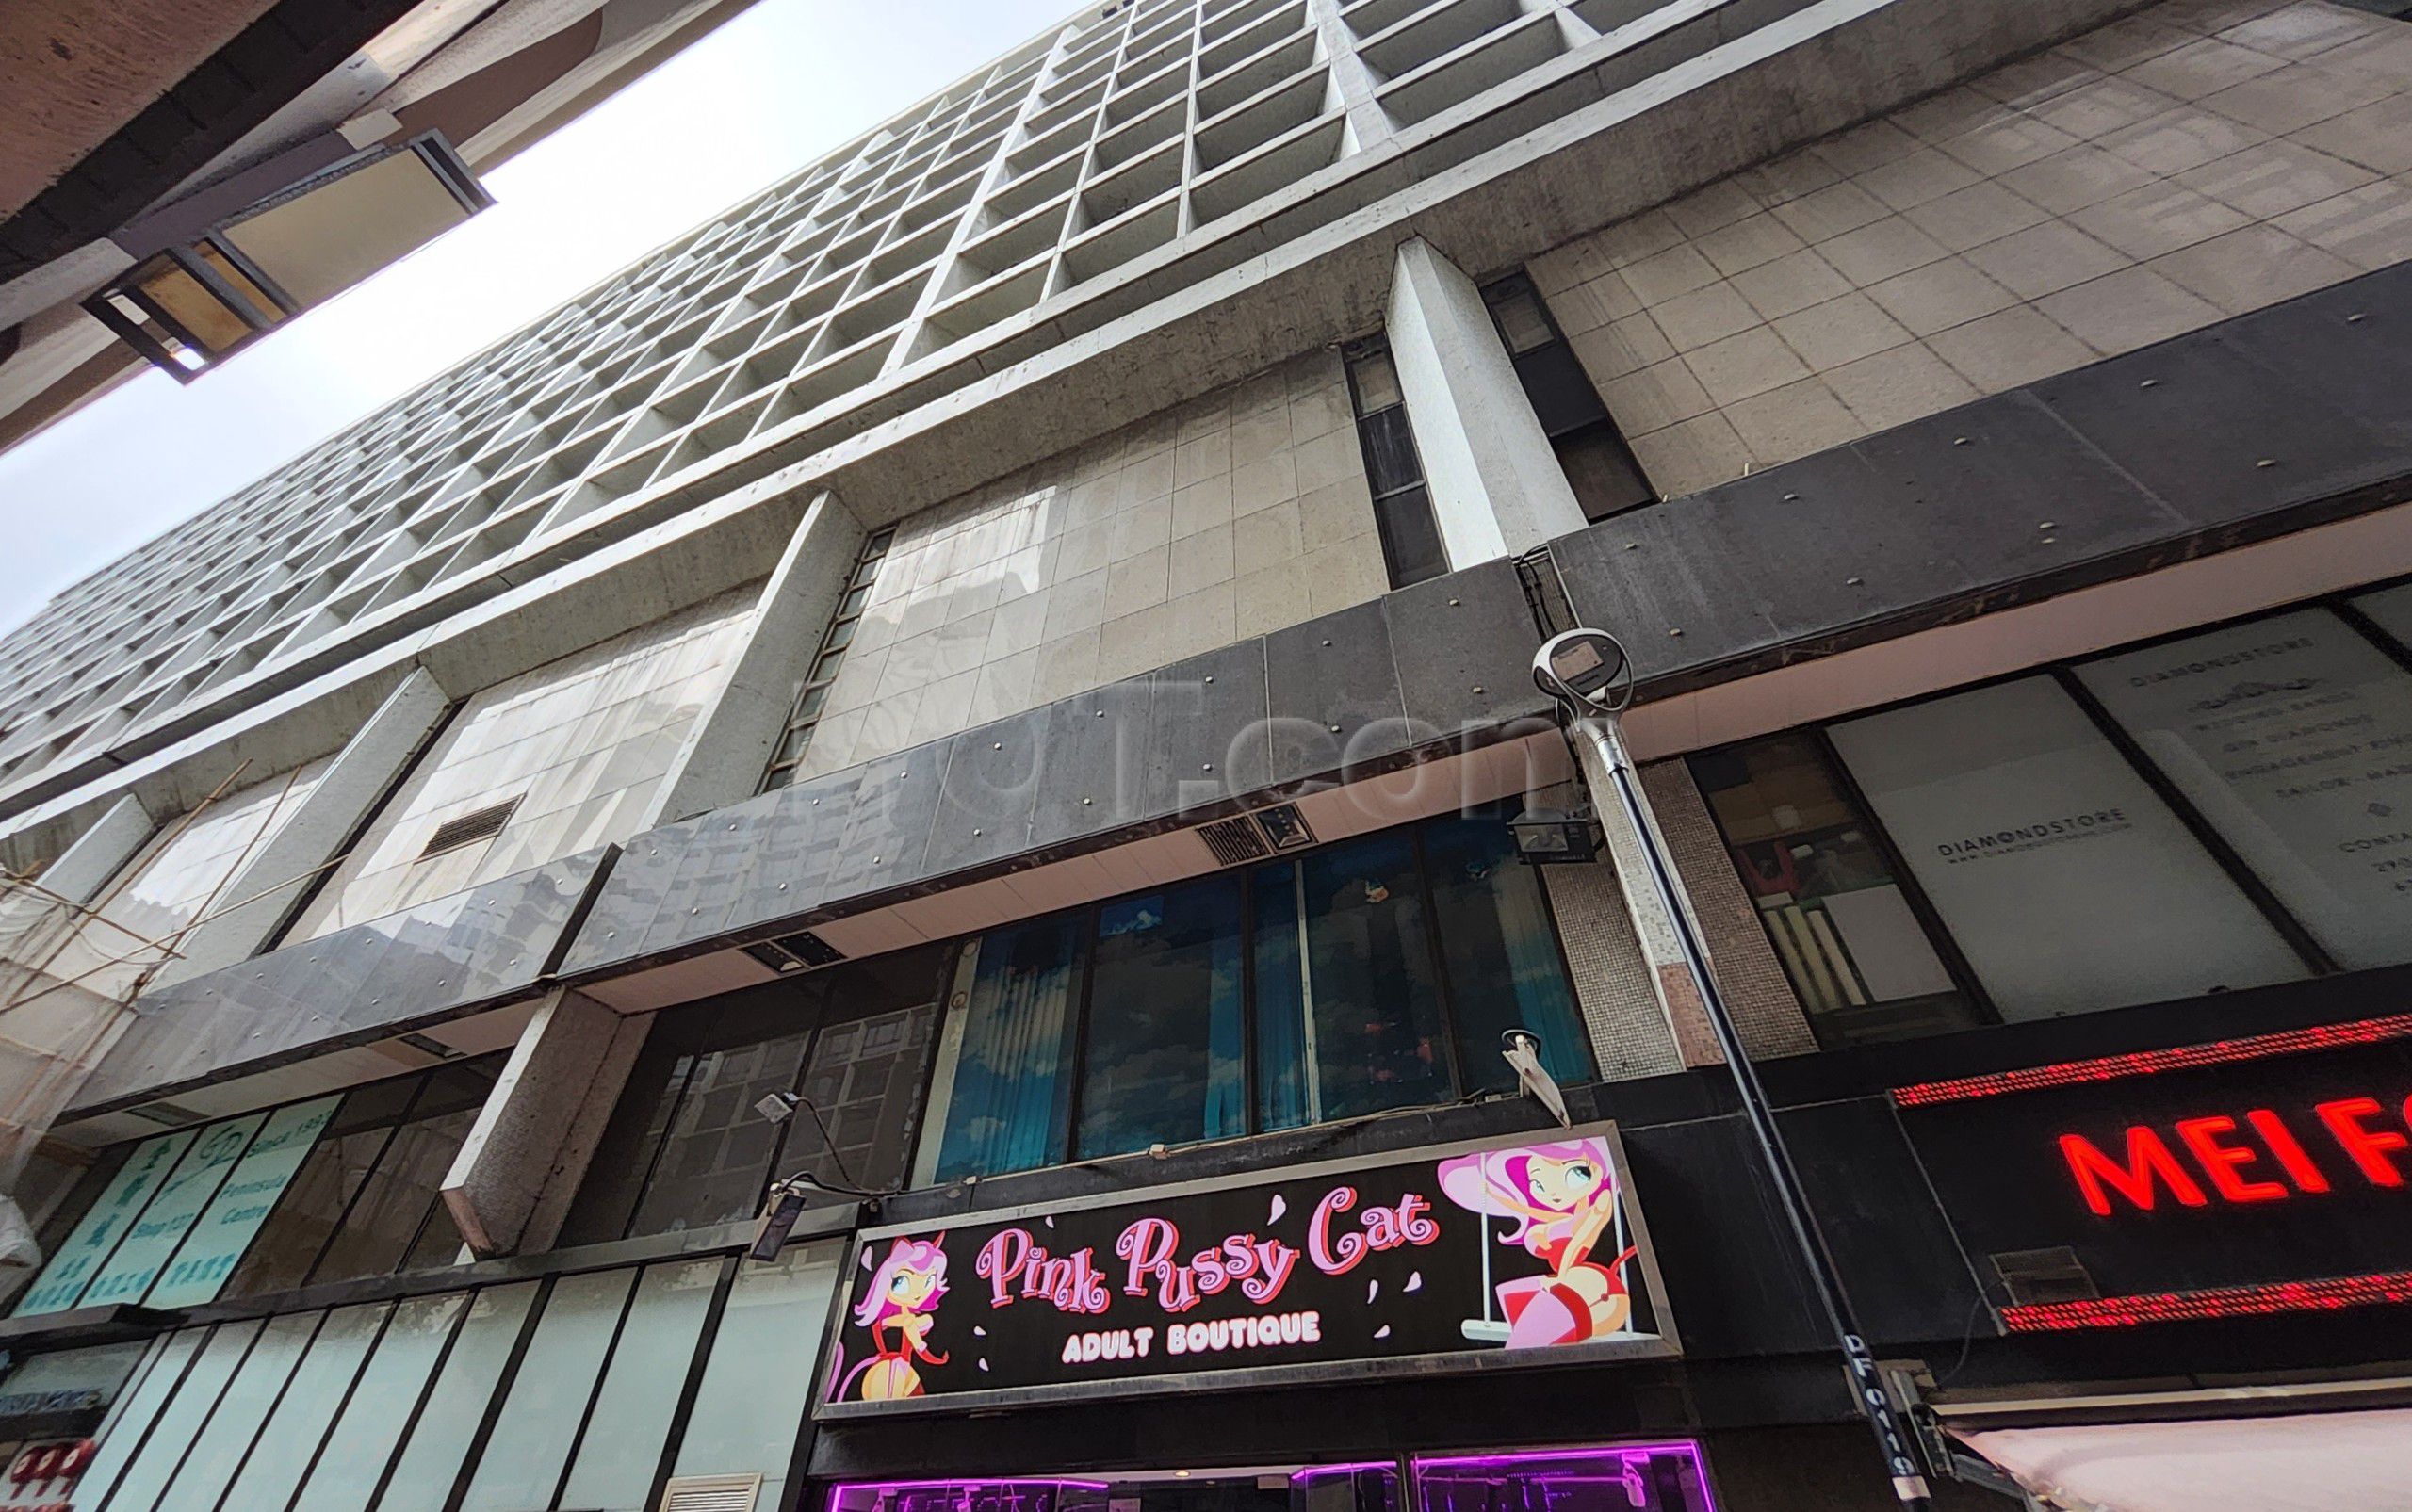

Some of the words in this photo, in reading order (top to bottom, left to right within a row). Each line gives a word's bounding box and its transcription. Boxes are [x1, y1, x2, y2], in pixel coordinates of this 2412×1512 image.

[1937, 807, 2127, 856] DIAMONDSTORE
[2058, 1108, 2330, 1216] MEI
[2314, 1095, 2412, 1188] F
[976, 1228, 1110, 1314] Pink
[1116, 1218, 1300, 1312] Pussy
[1309, 1187, 1440, 1275] Cat
[1062, 1329, 1153, 1363] ADULT
[1167, 1311, 1321, 1355] BOUTIQUE
